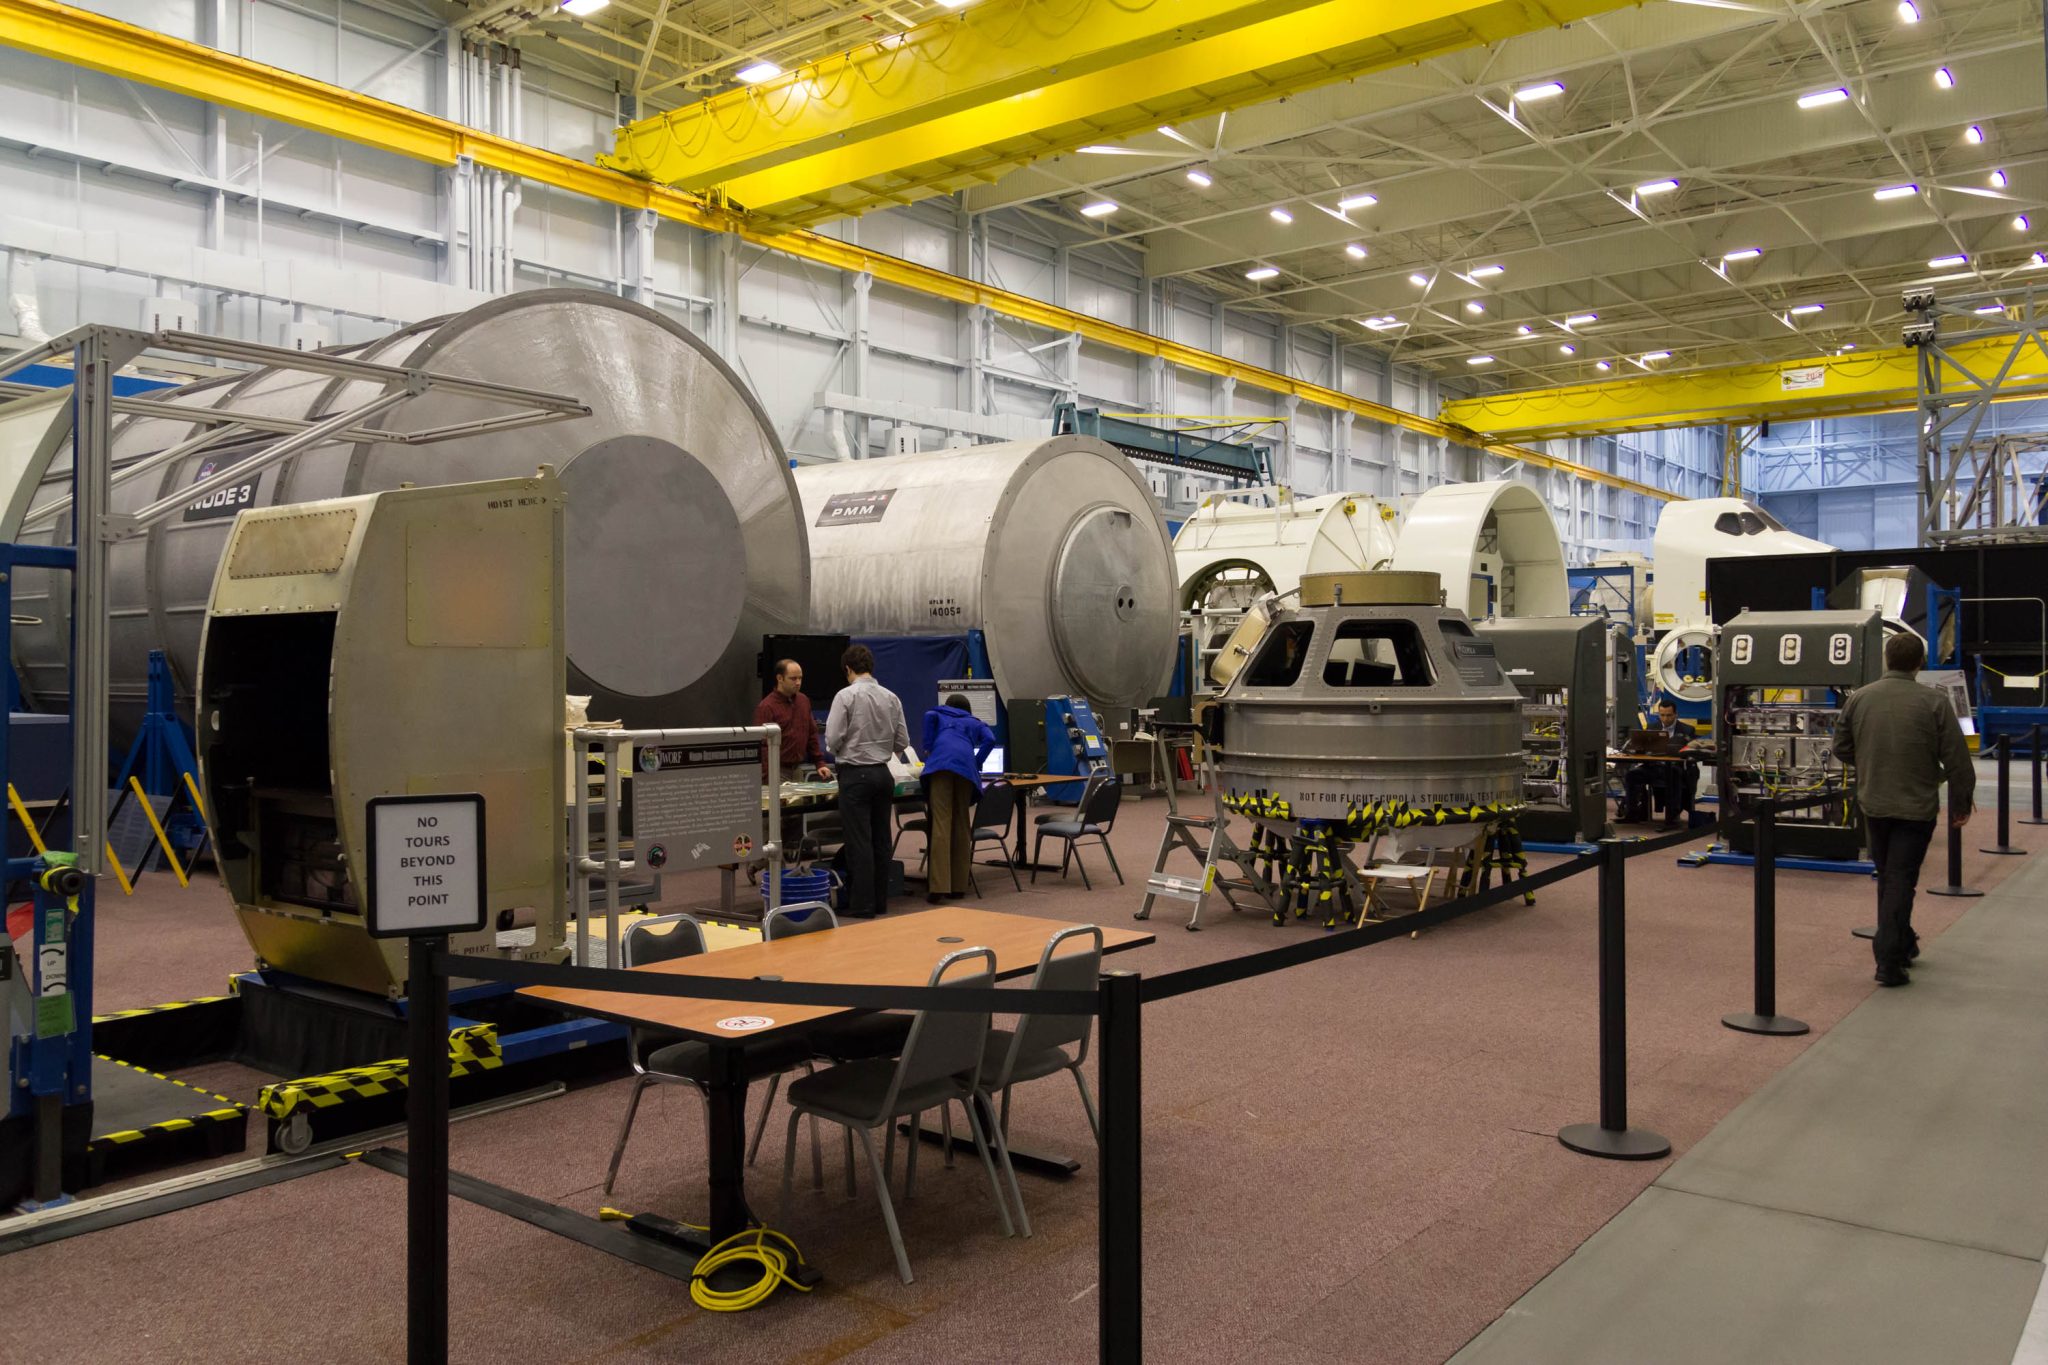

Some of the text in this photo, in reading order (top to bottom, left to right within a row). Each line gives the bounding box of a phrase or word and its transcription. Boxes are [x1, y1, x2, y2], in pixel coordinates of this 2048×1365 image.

[239, 485, 252, 503] 3
[831, 504, 875, 517] PMM
[1299, 791, 1316, 801] NOT
[1319, 792, 1337, 802] FOR
[1420, 792, 1473, 803] STRUCTURAL
[1477, 790, 1494, 801] TEST
[417, 817, 438, 828] NO
[405, 835, 450, 848] TOURS
[400, 855, 455, 868] BEYOND
[413, 875, 443, 886] THIS
[408, 894, 449, 907] POINT
